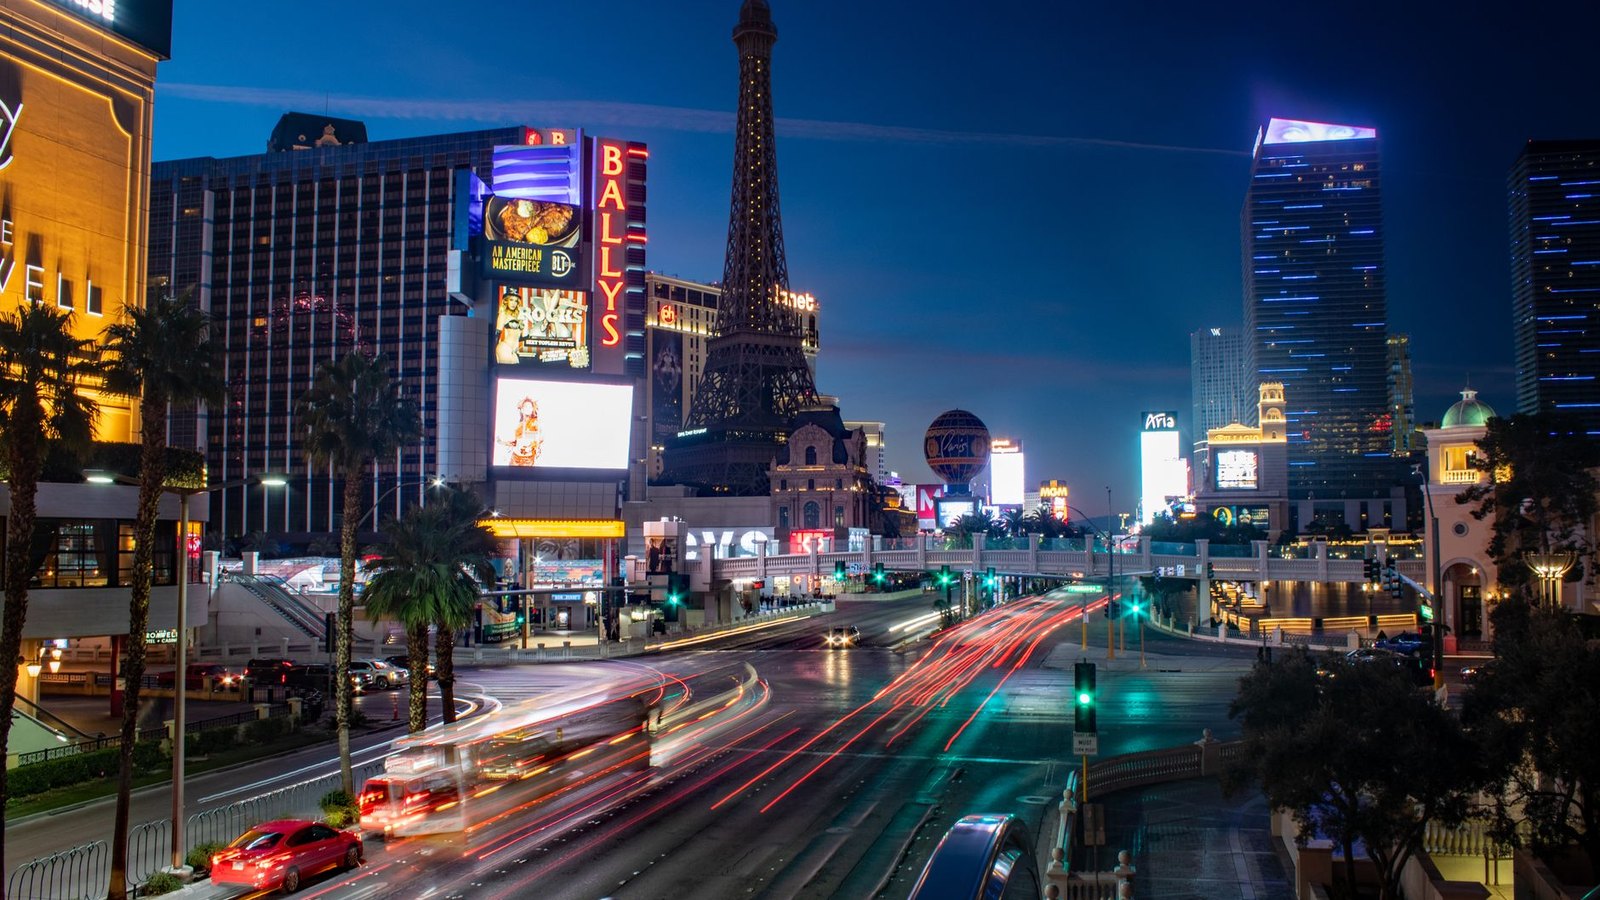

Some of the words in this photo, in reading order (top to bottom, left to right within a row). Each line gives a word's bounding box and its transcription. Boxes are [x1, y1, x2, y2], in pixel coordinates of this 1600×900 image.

[492, 245, 503, 258] AN
[506, 246, 543, 262] AMERICAN
[598, 145, 625, 345] BALLYS
[492, 256, 541, 273] MASTERPIECE
[551, 255, 566, 272] BLT
[1145, 412, 1175, 430] Aria
[941, 431, 968, 459] Paris
[1040, 486, 1068, 498] MGM
